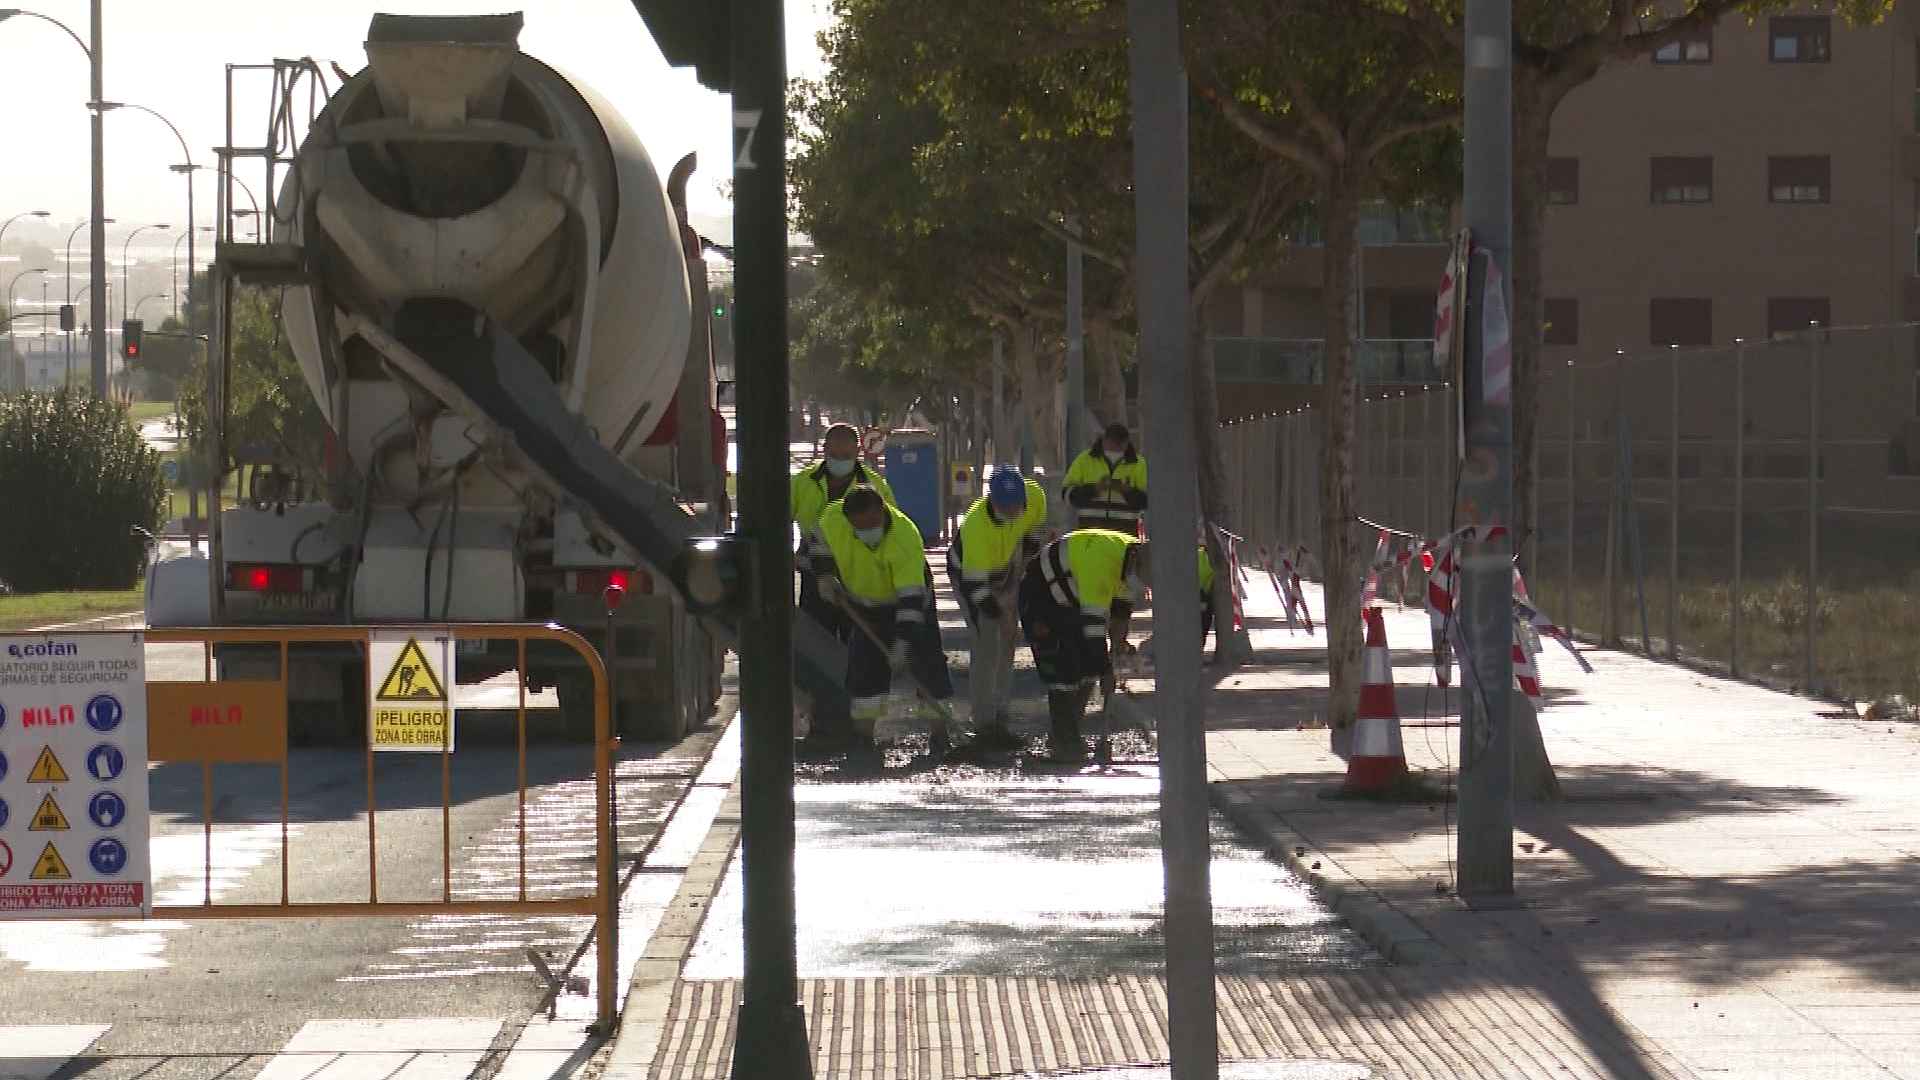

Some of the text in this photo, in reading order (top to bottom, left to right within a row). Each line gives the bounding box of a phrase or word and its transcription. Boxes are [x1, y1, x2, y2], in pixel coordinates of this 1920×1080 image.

[98, 659, 138, 671] TODAS
[41, 673, 58, 685] DE
[60, 672, 129, 684] SEGURIDAD
[375, 729, 400, 744] ZONA
[402, 729, 415, 744] DE
[37, 886, 52, 896] EL
[55, 885, 87, 896] PASO
[90, 885, 98, 895] A
[102, 884, 135, 895] TODA
[30, 898, 66, 908] AJENA
[71, 897, 80, 907] A
[82, 897, 97, 907] LA
[100, 896, 136, 906] OBRA
